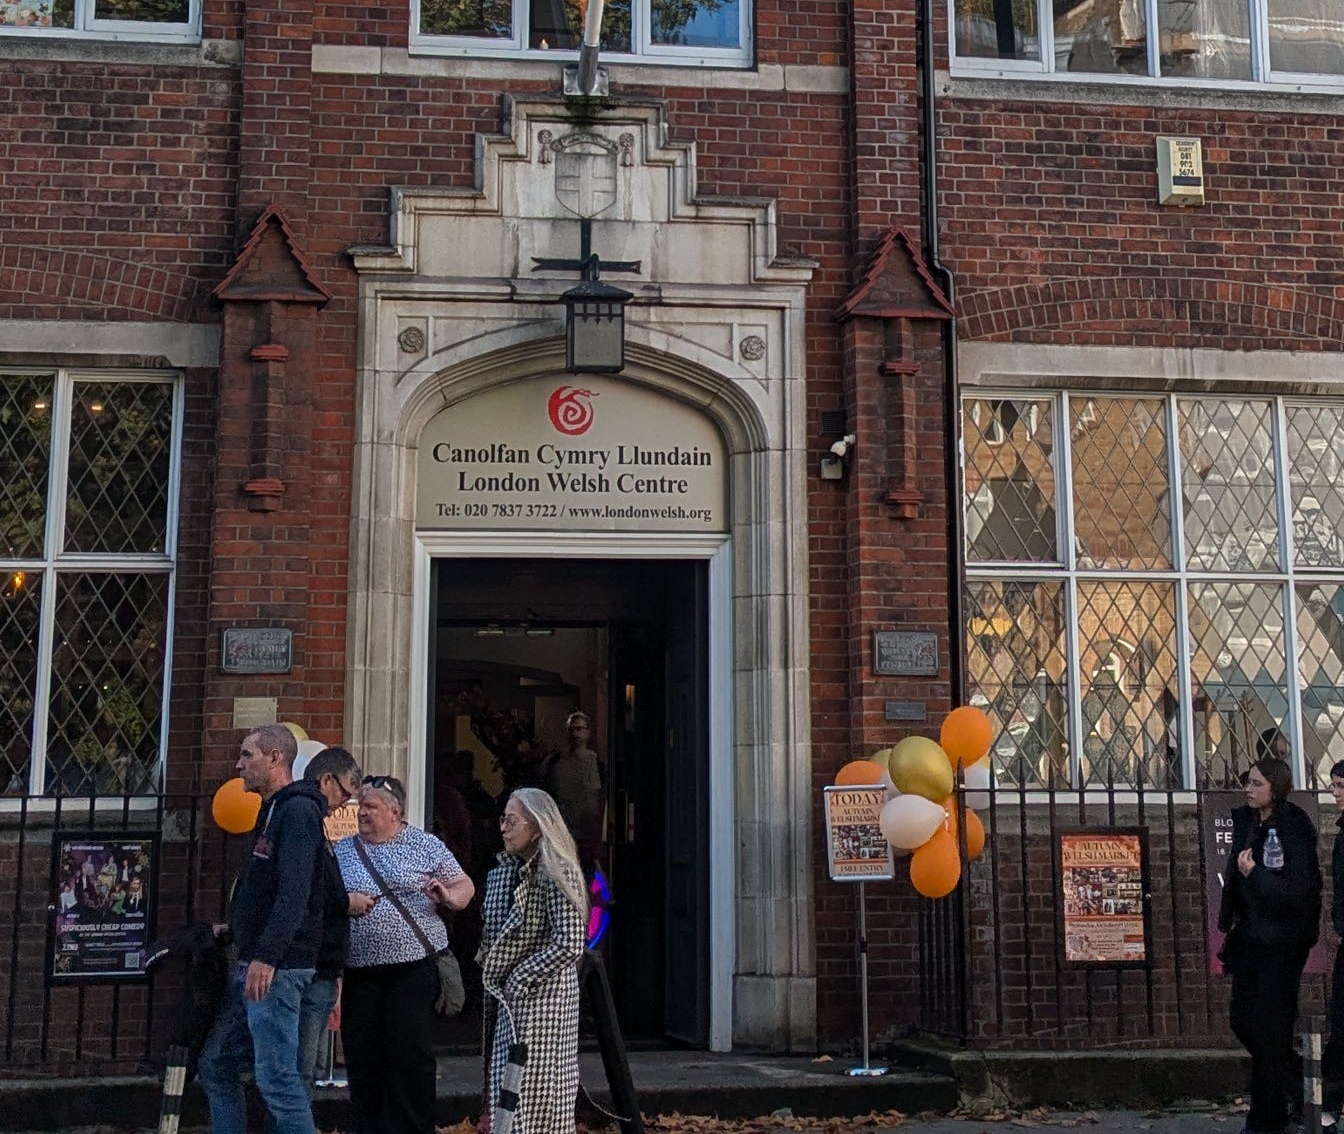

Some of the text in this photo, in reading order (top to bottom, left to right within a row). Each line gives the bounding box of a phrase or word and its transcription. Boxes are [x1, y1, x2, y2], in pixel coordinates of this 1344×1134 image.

[432, 443, 712, 469] Canolfan Cymry Llundain
[457, 471, 688, 494] London Welsh Centre
[436, 503, 460, 517] Tel:
[464, 504, 488, 517] 020
[492, 504, 522, 517] 7837
[527, 504, 557, 518] 3722
[568, 505, 712, 522] www.londonwelsh.org
[834, 793, 881, 805] TODAY
[1082, 842, 1121, 850] AUTUMN
[121, 922, 145, 930] COMEDY
